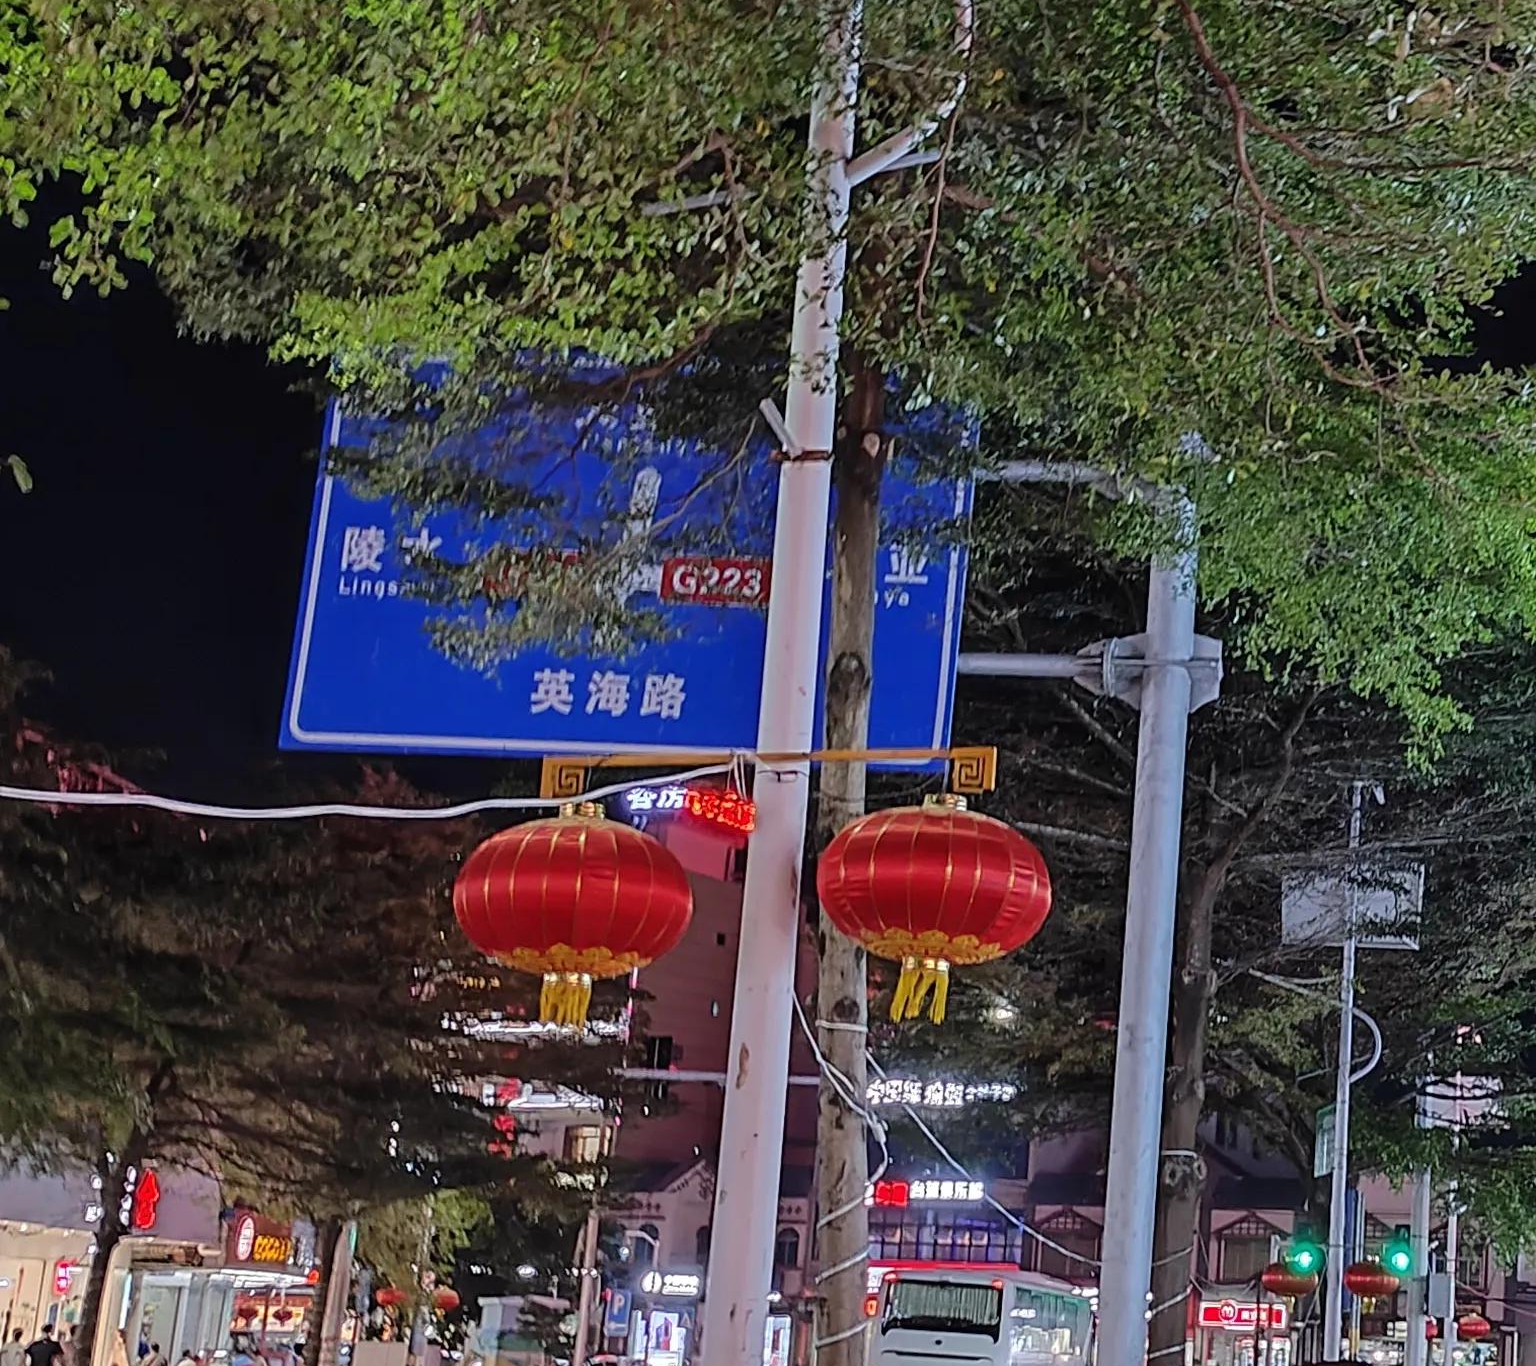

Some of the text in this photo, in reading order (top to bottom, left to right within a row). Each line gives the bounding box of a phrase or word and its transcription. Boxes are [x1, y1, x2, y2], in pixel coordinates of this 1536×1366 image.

[671, 564, 763, 597] G223
[530, 667, 686, 720] 英海路
